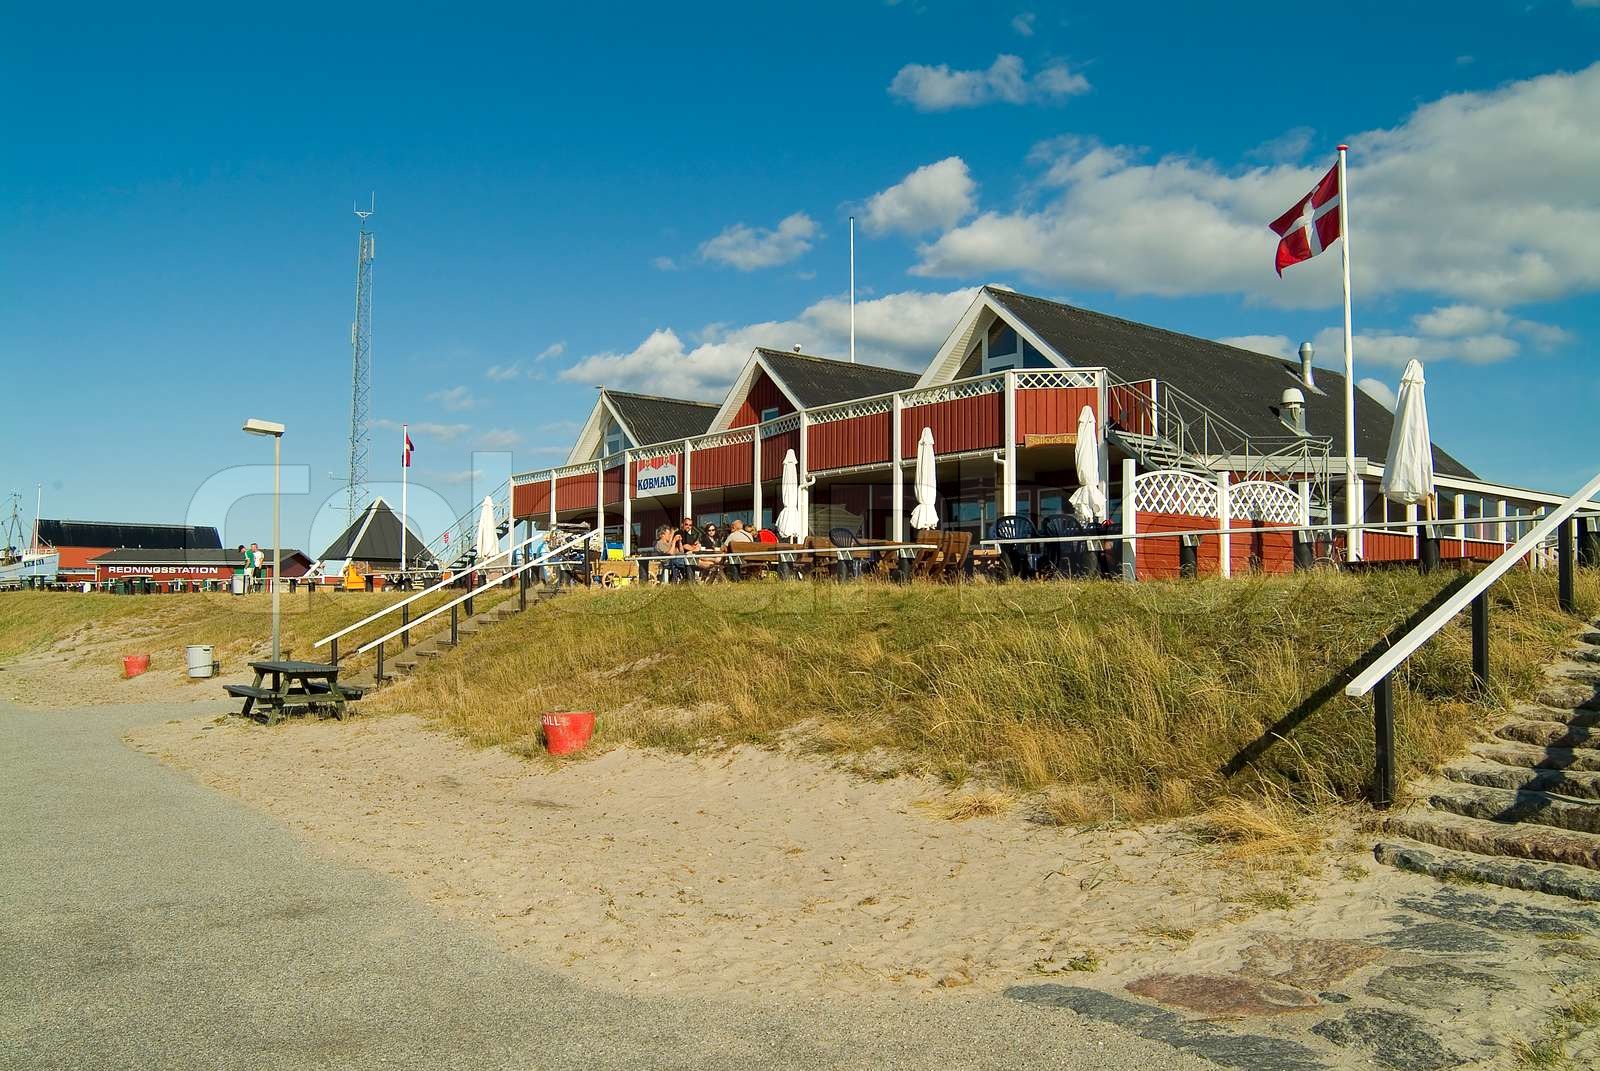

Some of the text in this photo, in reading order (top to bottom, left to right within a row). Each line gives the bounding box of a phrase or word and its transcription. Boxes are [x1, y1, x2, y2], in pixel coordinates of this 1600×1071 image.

[1028, 436, 1061, 445] Sailor's
[638, 475, 676, 490] KØBMAND
[108, 566, 218, 574] REDNINGSSTATION
